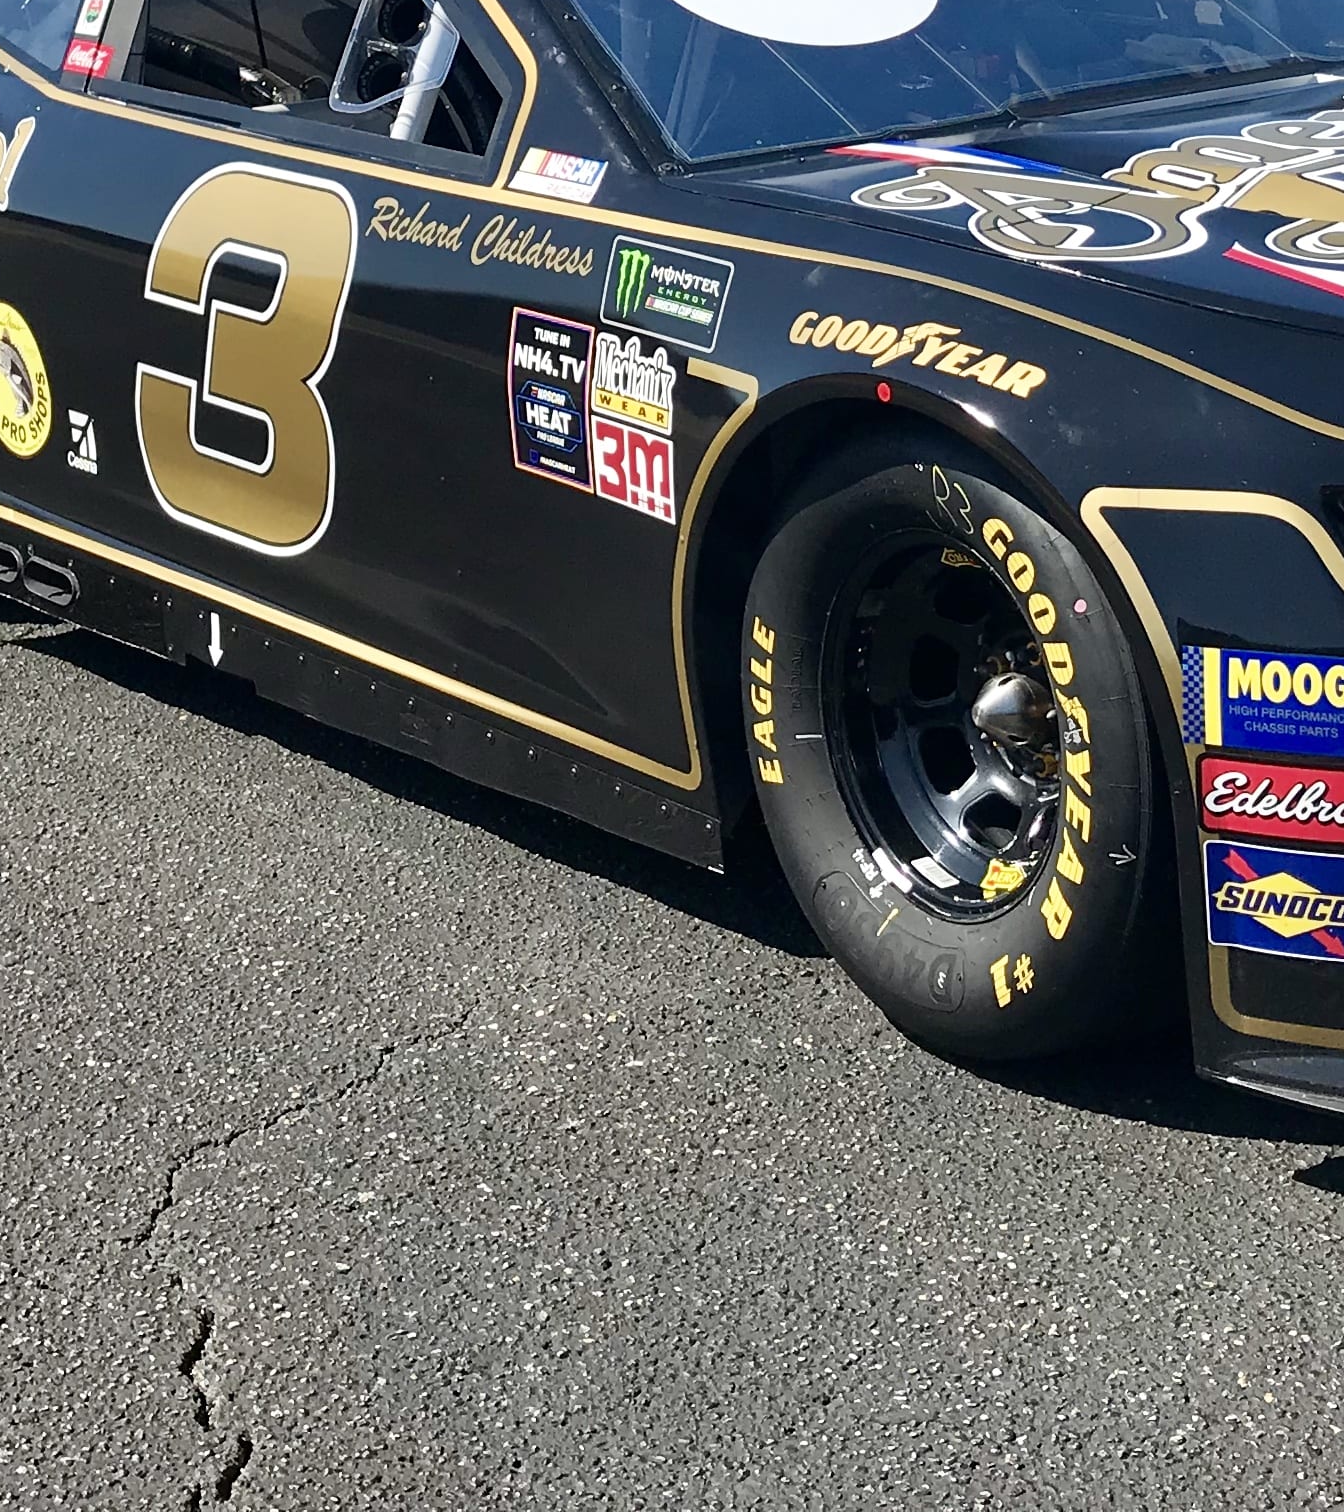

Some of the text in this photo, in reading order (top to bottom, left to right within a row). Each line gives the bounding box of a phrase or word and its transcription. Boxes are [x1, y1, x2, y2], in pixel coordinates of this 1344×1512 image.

[542, 152, 600, 185] NASCAR
[365, 196, 595, 278] Richard Childress
[650, 264, 720, 297] MONSTER
[658, 286, 707, 306] ENERGY
[533, 327, 570, 348] TUNE IN
[788, 310, 1049, 399] GOODYEAR
[135, 162, 358, 558] 3
[514, 343, 586, 384] NH4.TV
[596, 335, 675, 409] Mechanix
[1, 415, 26, 444] PRO
[28, 372, 48, 439] SHOPS
[536, 387, 566, 406] NASCAR
[599, 393, 665, 425] WEAR
[525, 401, 572, 436] HEAT
[67, 450, 98, 475] Cessna
[596, 420, 672, 520] 3M
[742, 614, 784, 786] EAGLE
[1228, 703, 1258, 719] HIGH
[981, 517, 1094, 941] GOODYEAR
[1243, 720, 1340, 740] CHASSIS PARTS
[990, 868, 1020, 885] AERO
